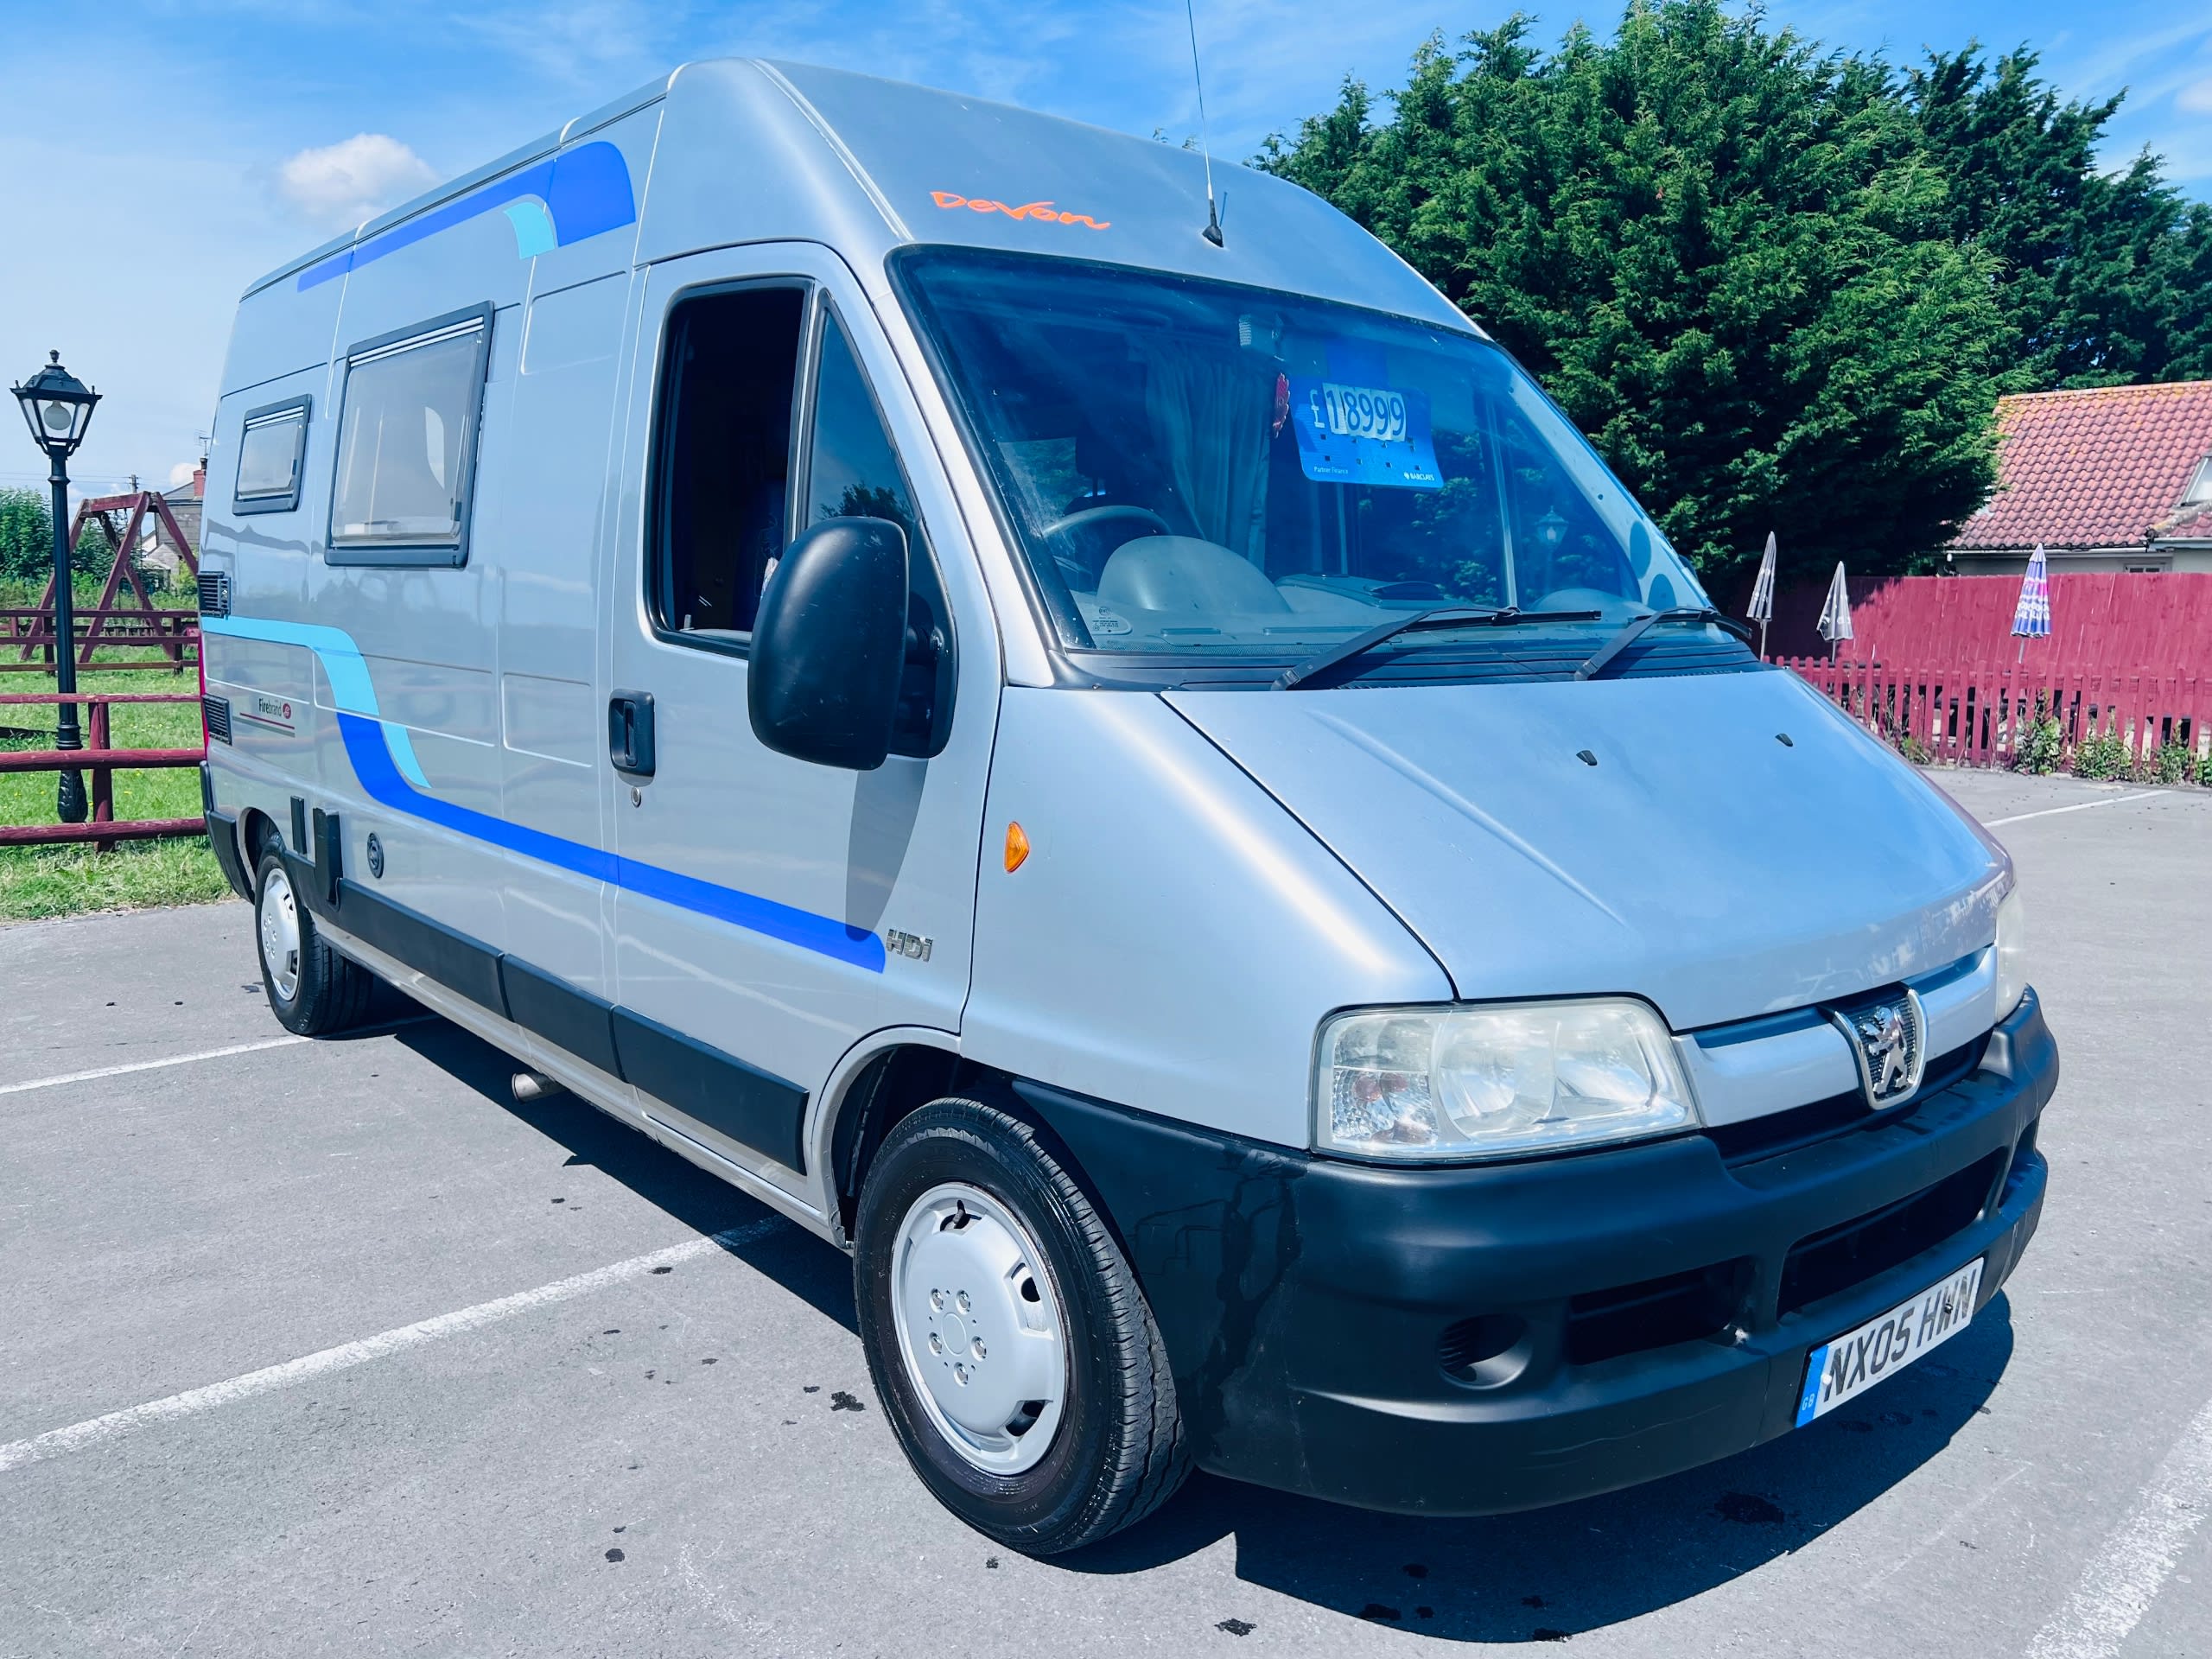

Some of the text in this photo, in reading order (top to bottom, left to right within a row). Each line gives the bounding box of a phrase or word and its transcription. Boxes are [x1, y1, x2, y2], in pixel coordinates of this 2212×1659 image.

[1310, 389, 1406, 436] £18999
[258, 697, 283, 717] Firebrand
[1823, 1268, 1977, 1403] NX05 HWN
[1802, 1393, 1815, 1411] GB
